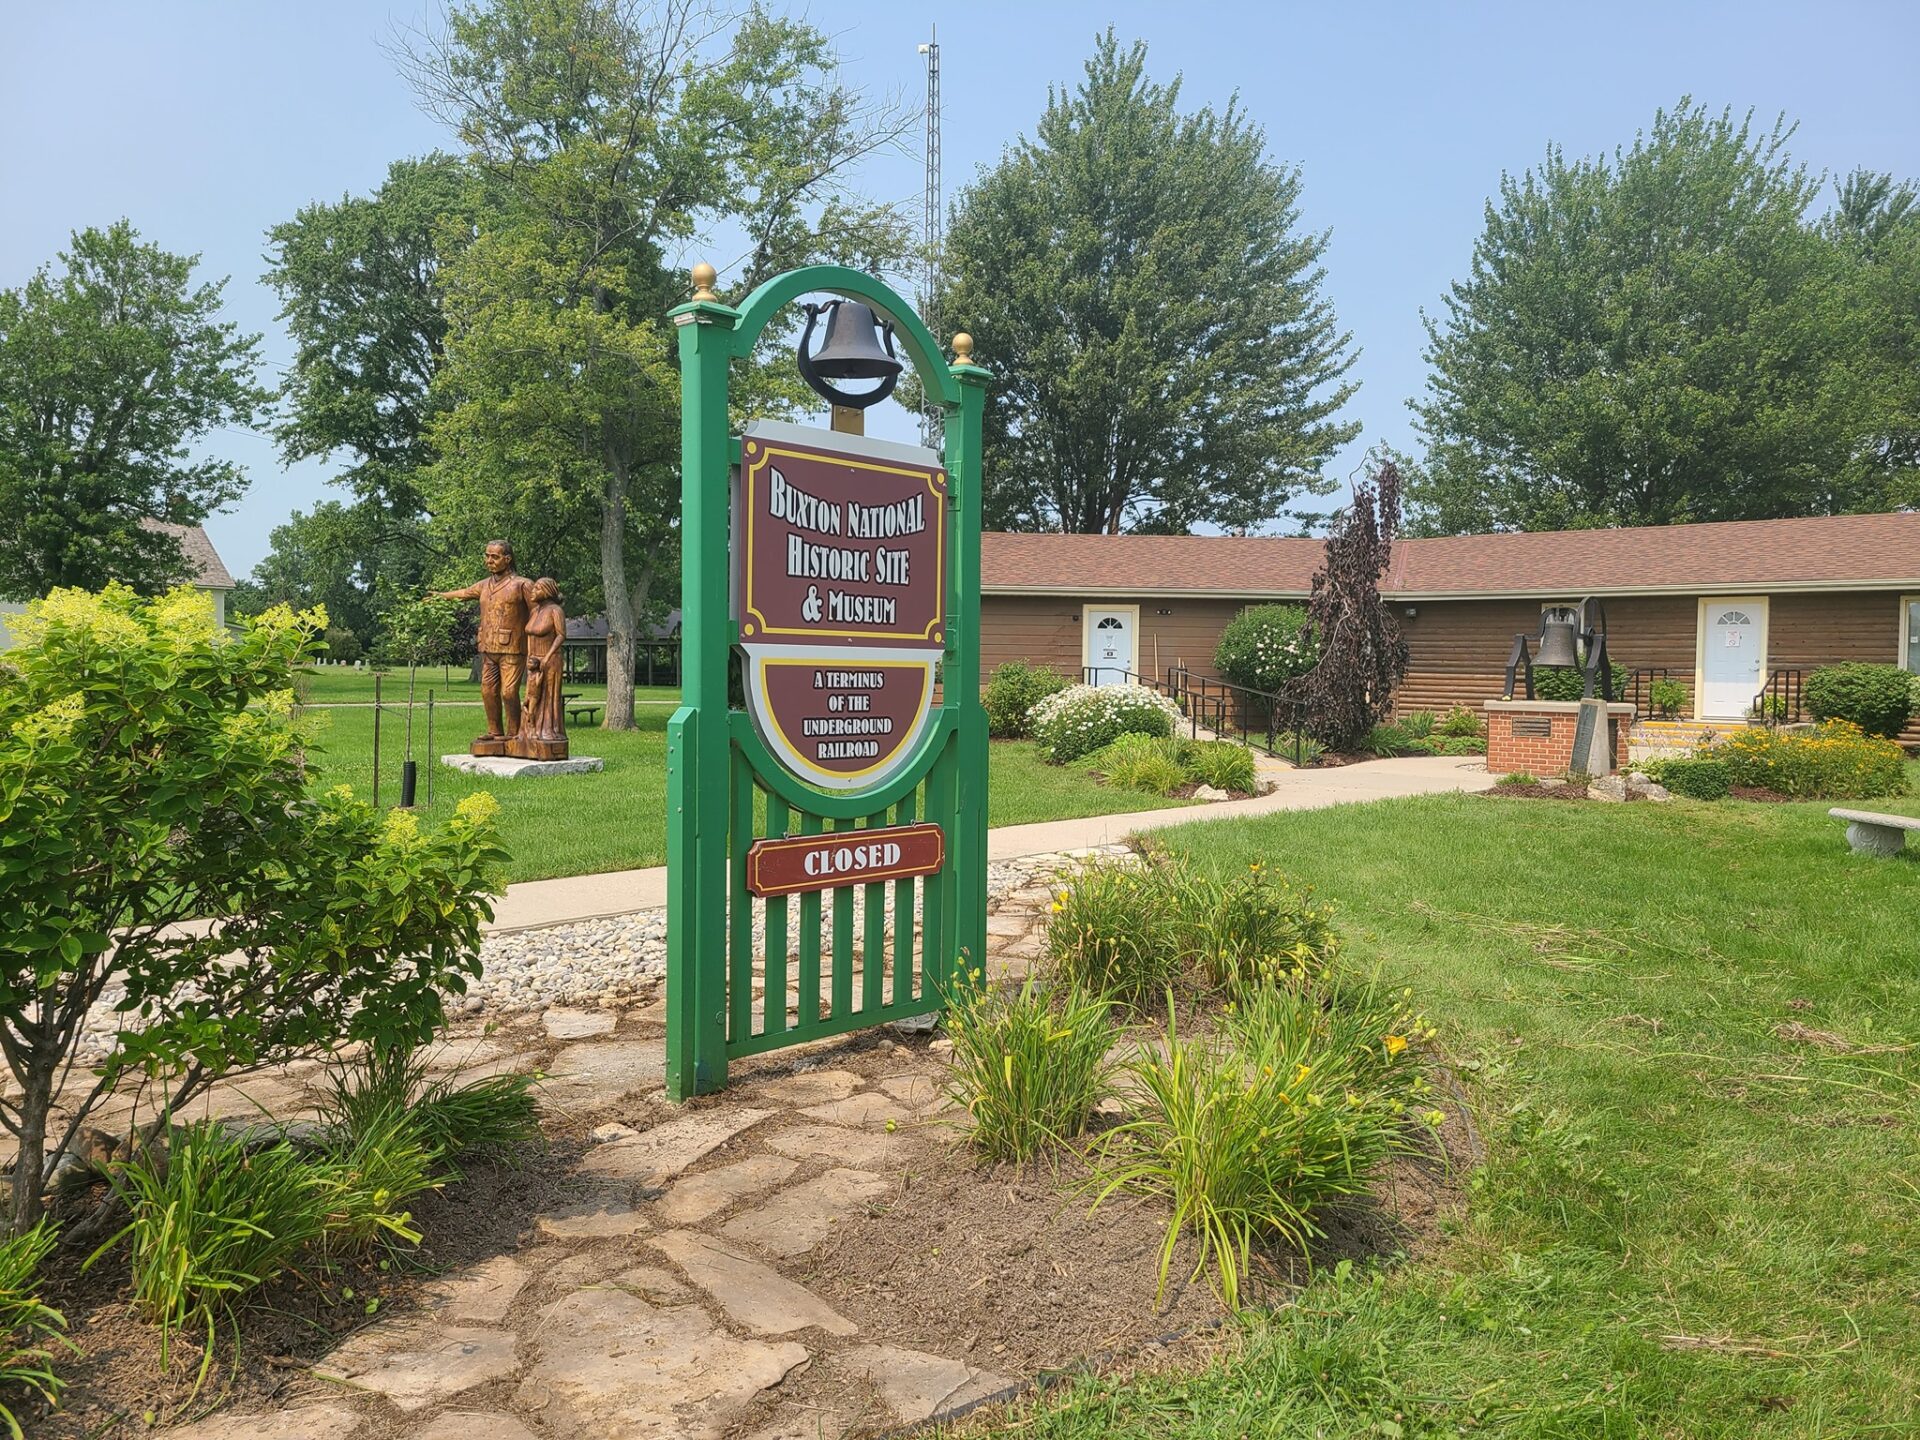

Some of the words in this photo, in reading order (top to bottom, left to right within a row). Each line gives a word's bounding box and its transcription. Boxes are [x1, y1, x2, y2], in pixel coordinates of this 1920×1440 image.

[801, 585, 823, 623] &
[814, 671, 824, 688] A
[826, 671, 884, 688] TERMINUS
[828, 696, 845, 712] OF
[847, 695, 870, 711] THE
[803, 718, 893, 736] UNDERGROUND
[817, 741, 879, 759] RAILROAD
[804, 842, 901, 876] CLOSED
